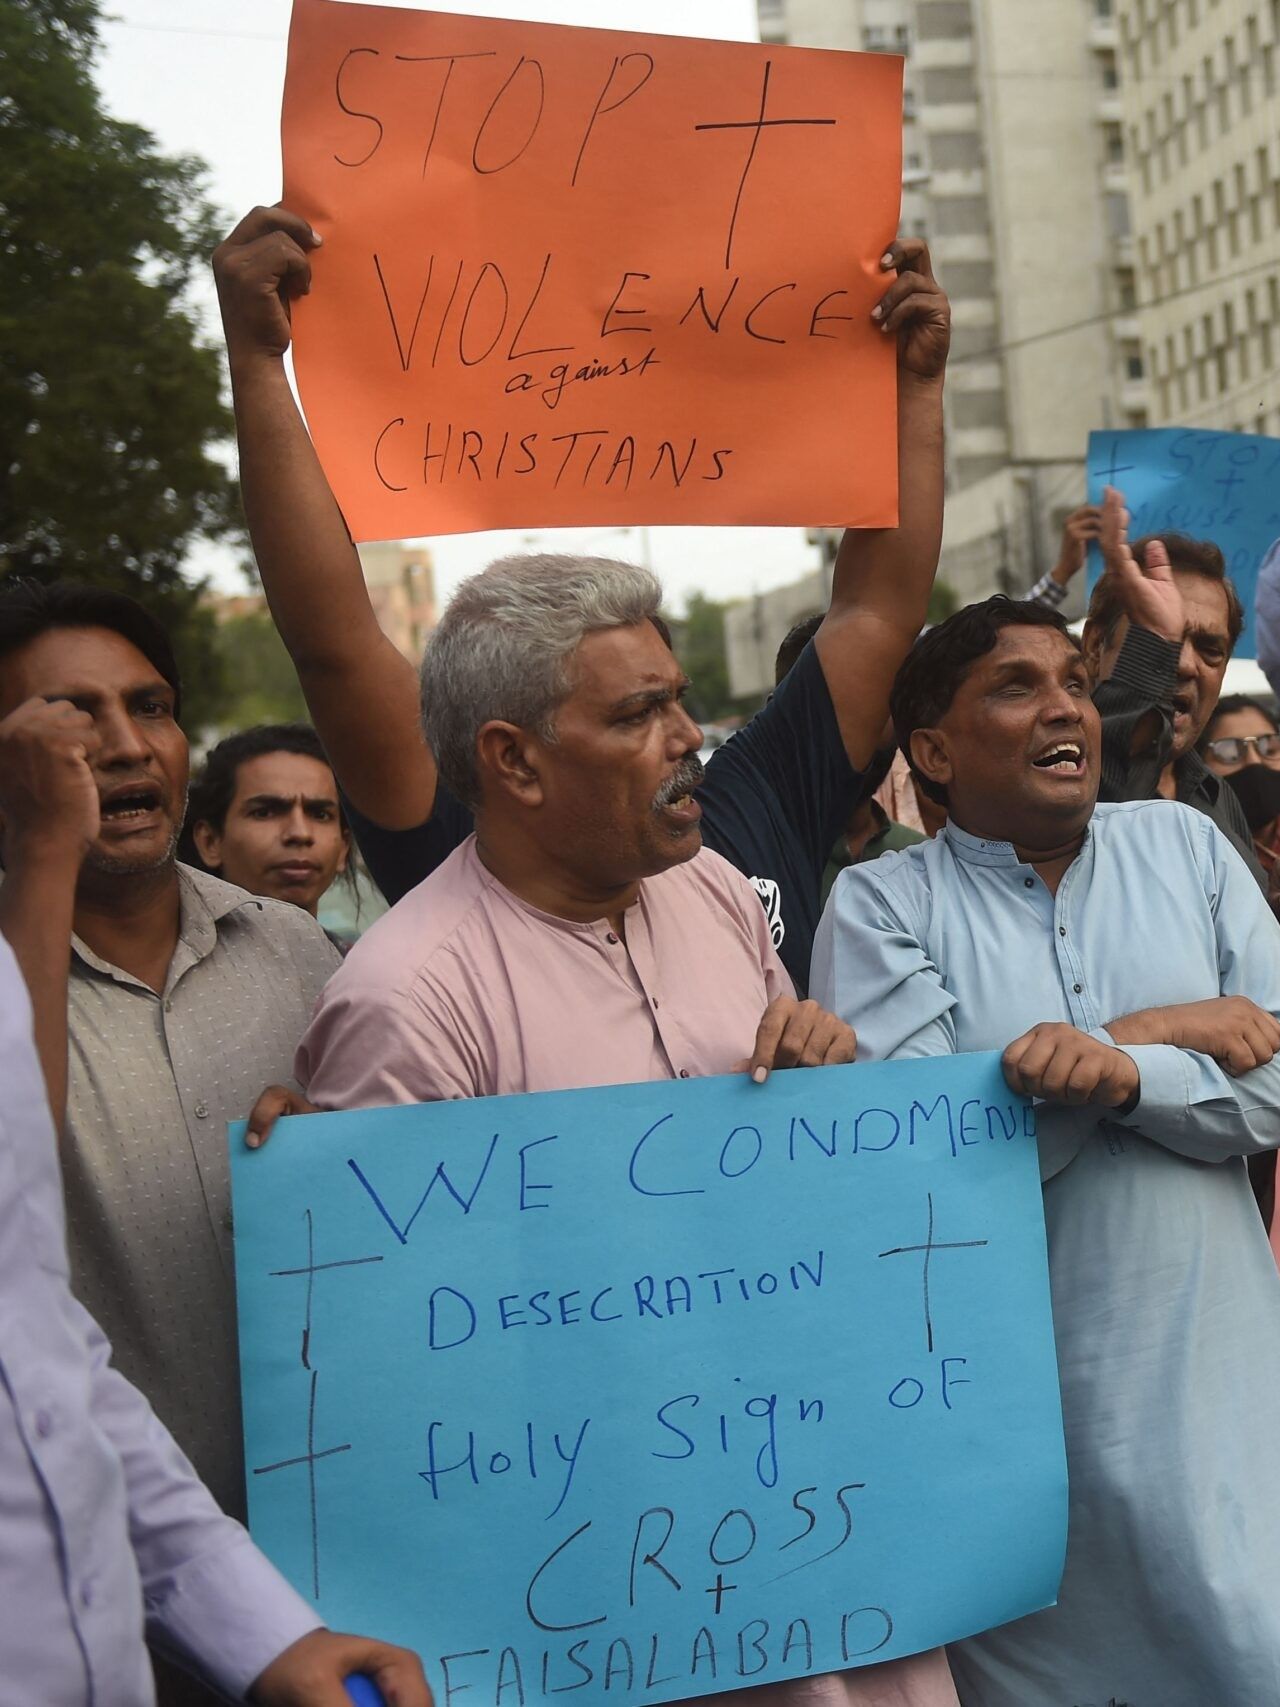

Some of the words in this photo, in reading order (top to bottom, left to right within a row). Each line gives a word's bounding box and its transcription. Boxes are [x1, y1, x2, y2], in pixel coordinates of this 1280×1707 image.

[334, 48, 655, 187] STOP
[373, 253, 854, 372] VIOLENCE
[505, 346, 661, 409] against
[374, 417, 735, 492] CHRISTIANS
[347, 1134, 559, 1246] WE
[428, 1251, 826, 1350] DESECRATION
[651, 1376, 825, 1488] Sign
[526, 1483, 867, 1632] CROSS
[440, 1606, 894, 1707] FAISALABAD
